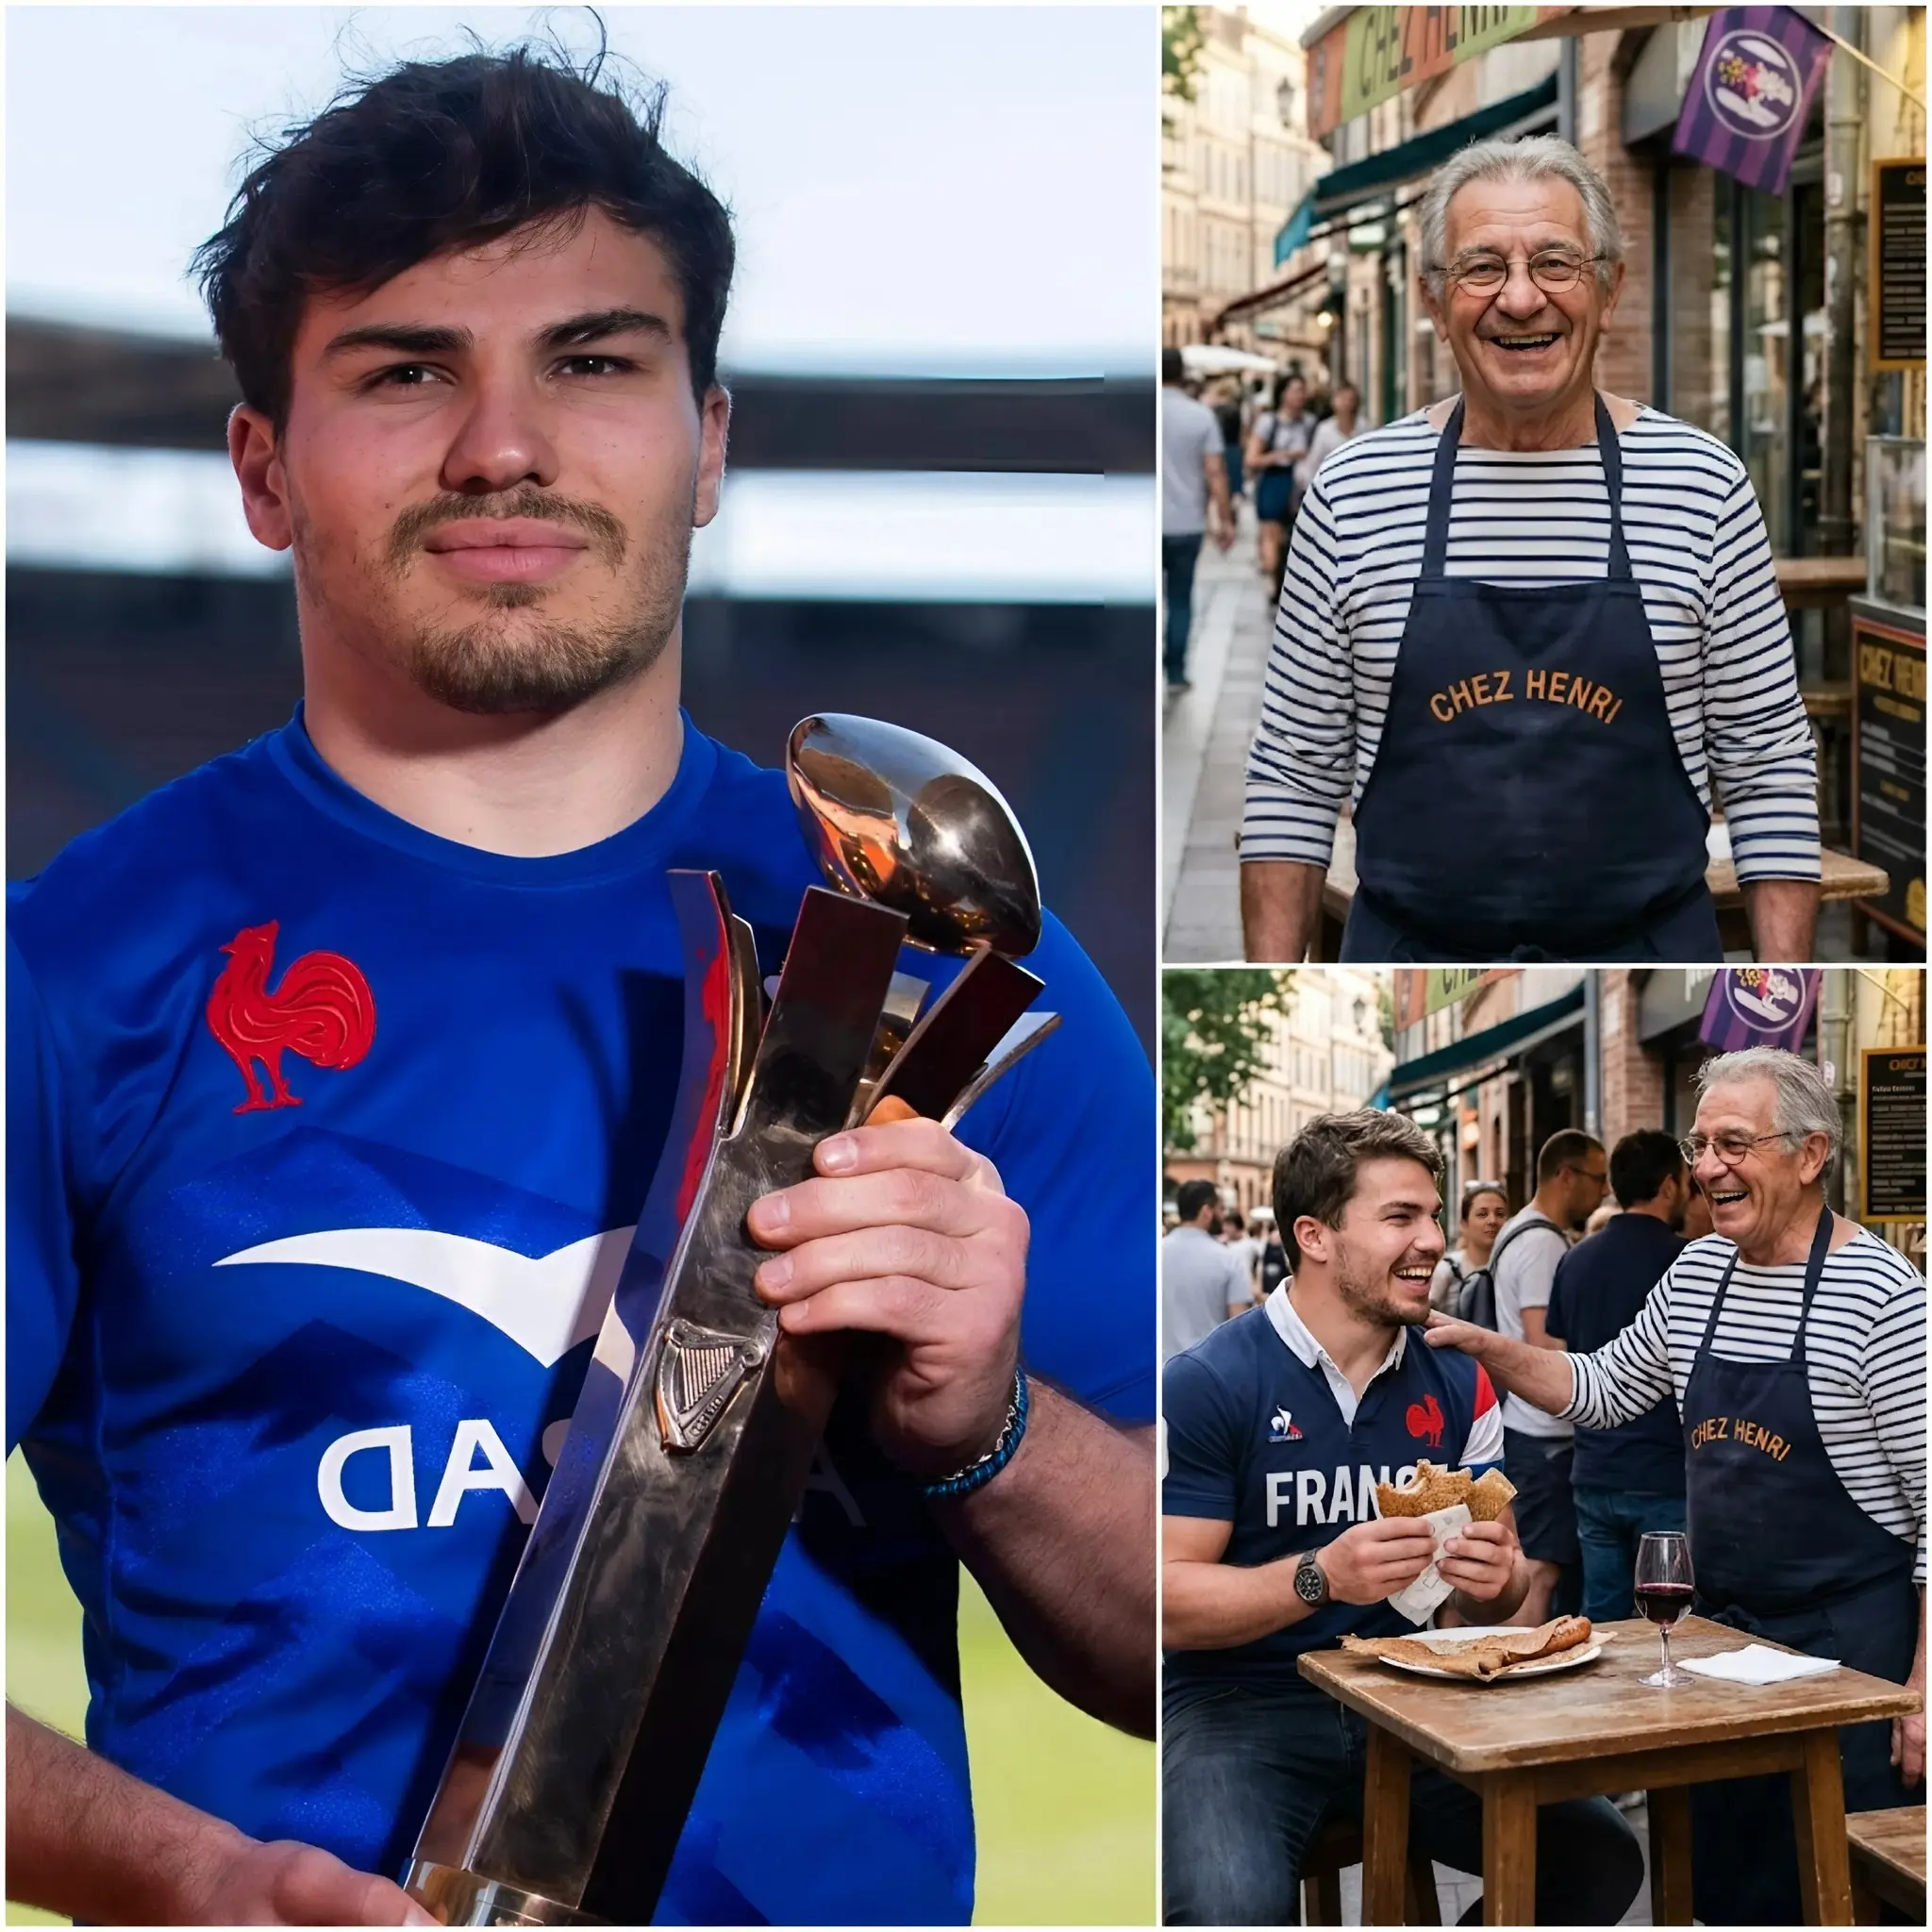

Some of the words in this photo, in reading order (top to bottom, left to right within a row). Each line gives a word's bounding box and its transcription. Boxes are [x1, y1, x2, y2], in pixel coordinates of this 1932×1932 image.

[1360, 6, 1412, 98] CHEZ
[1430, 671, 1514, 723] CHEZ
[1525, 669, 1623, 724] HENRI
[1690, 1417, 1728, 1450] CHEZ
[1734, 1418, 1791, 1461] HENRI
